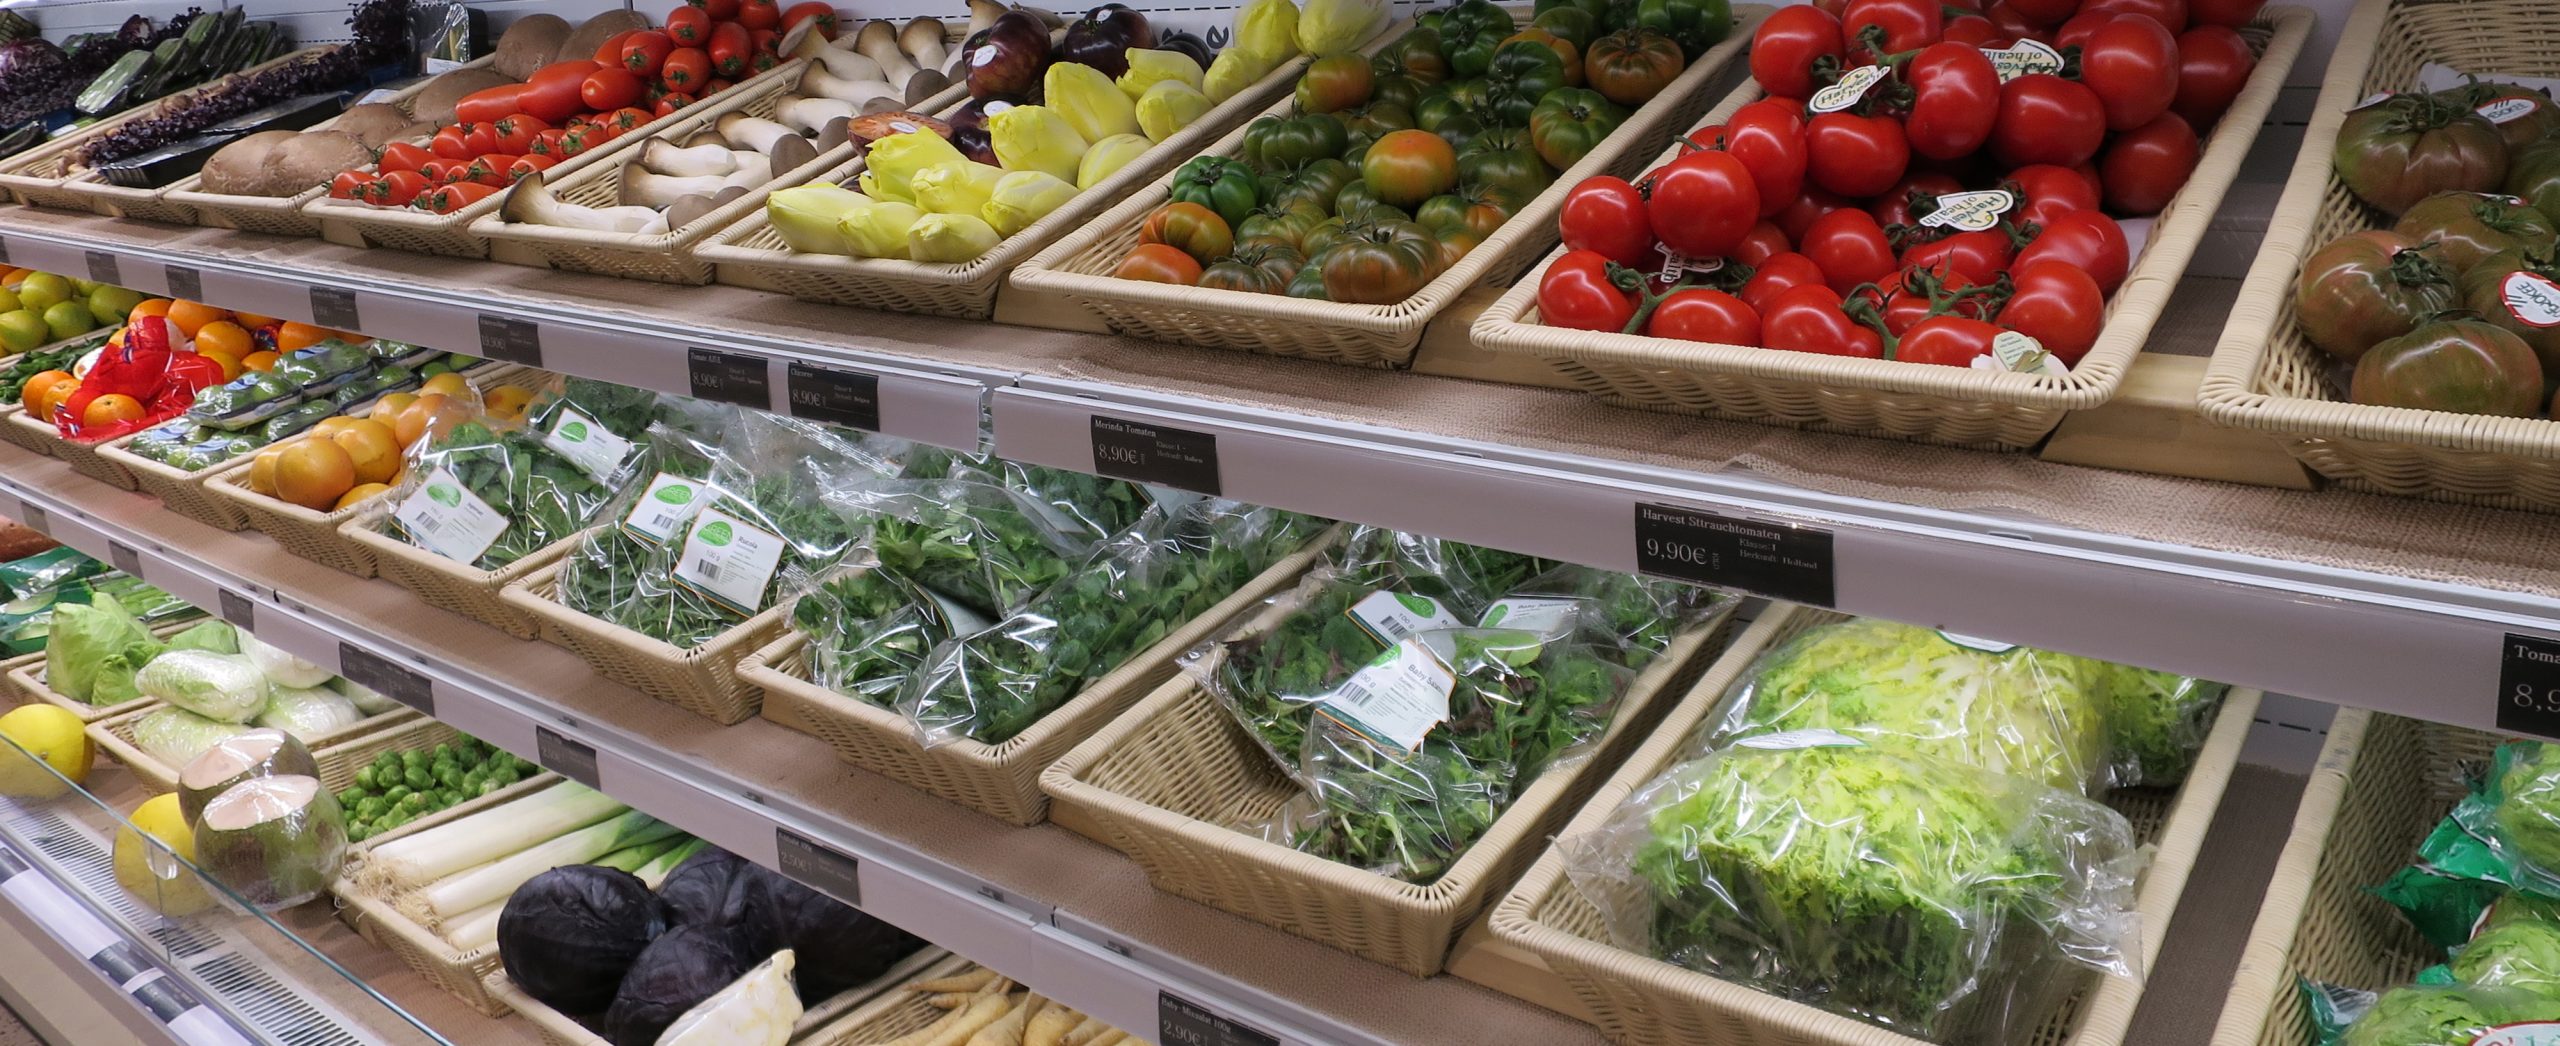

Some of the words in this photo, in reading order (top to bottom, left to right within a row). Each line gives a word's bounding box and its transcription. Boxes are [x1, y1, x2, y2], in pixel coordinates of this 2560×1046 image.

[2023, 51, 2042, 62] of
[792, 389, 822, 407] 8,90€
[1095, 420, 1123, 432] Merinda
[1125, 425, 1157, 438] Tomaten
[1098, 443, 1138, 465] 8,90€
[1643, 509, 1686, 525] Harvest
[1688, 516, 1781, 541] Sttrauchtomaten
[738, 535, 758, 549] Rucola
[1646, 538, 1708, 565] 9,90€
[1782, 557, 1818, 569] Holland
[1408, 664, 1427, 681] Baby
